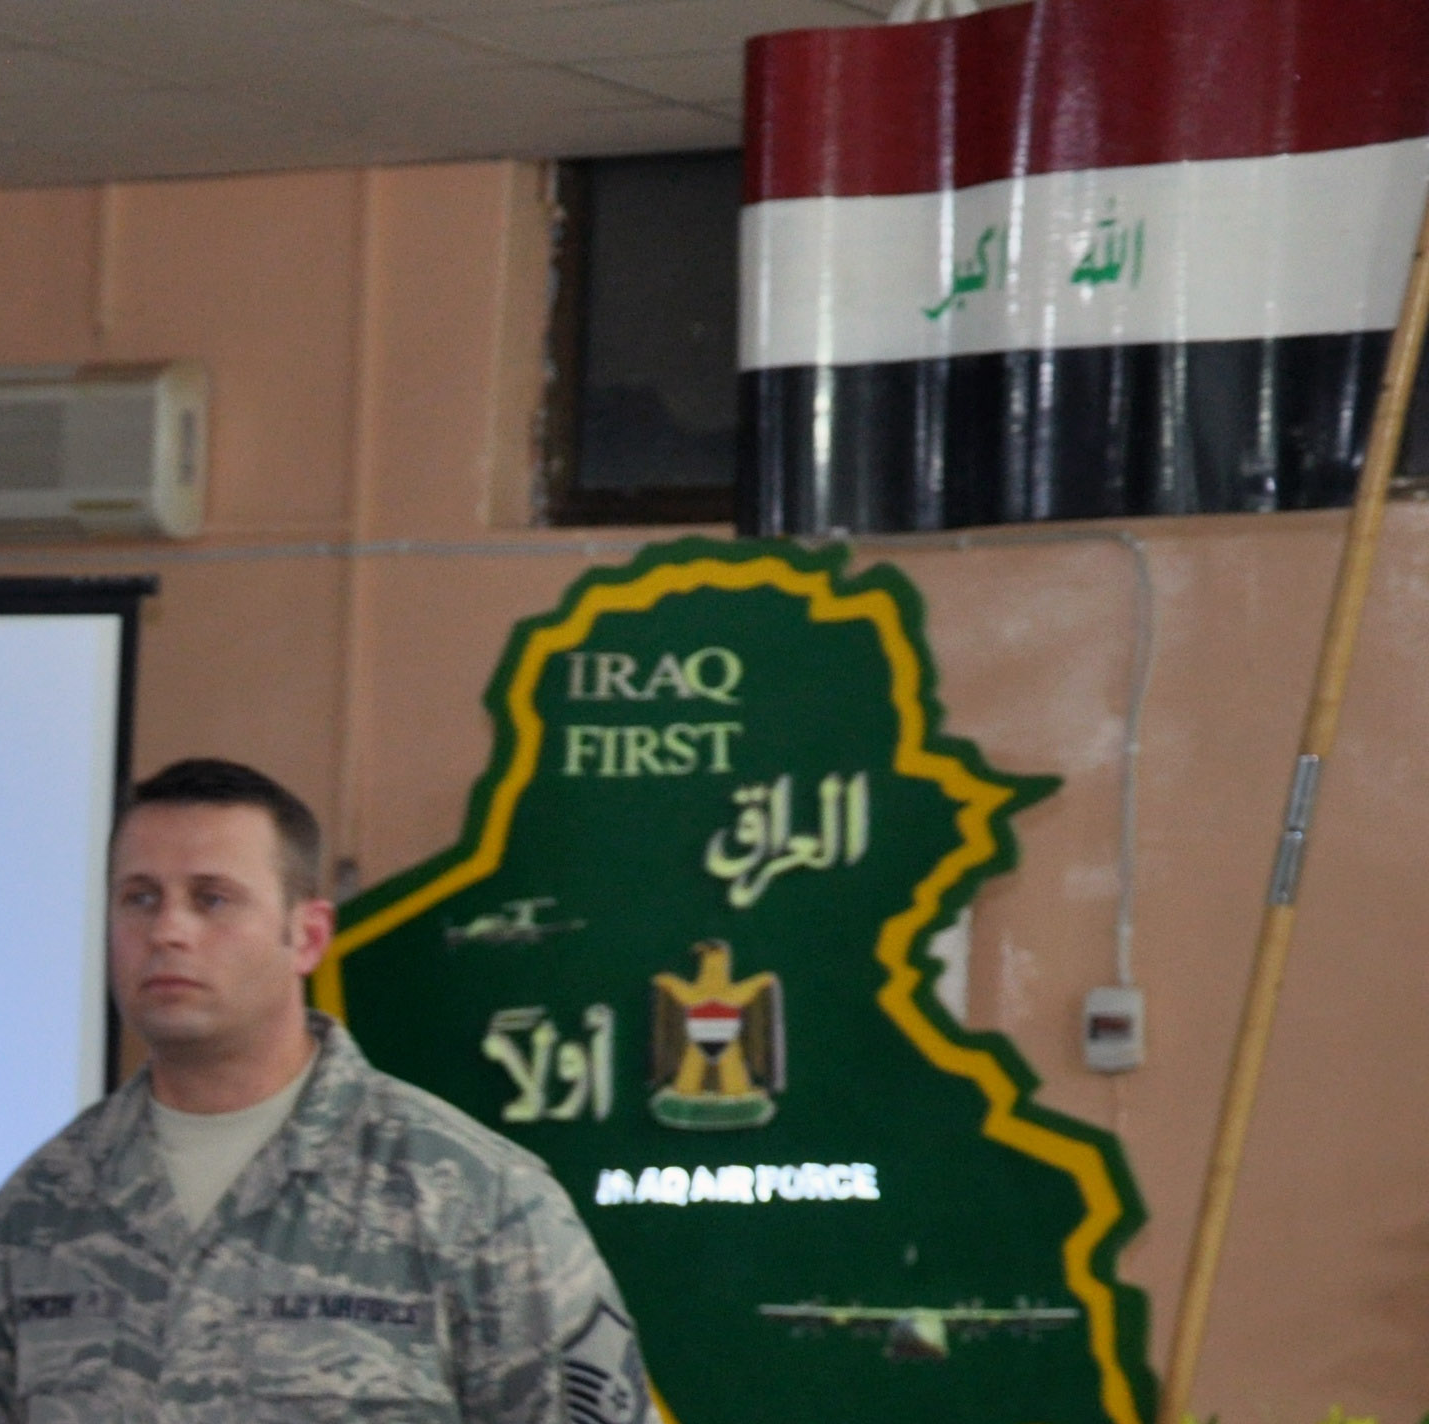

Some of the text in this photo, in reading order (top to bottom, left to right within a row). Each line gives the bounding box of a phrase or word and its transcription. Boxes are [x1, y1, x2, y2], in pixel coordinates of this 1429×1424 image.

[1071, 197, 1145, 290] الله
[566, 647, 743, 704] IRAQ
[563, 722, 744, 777] FIRST
[705, 772, 868, 908] العراق
[691, 1165, 755, 1204] AIR
[755, 1162, 881, 1202] FORCE
